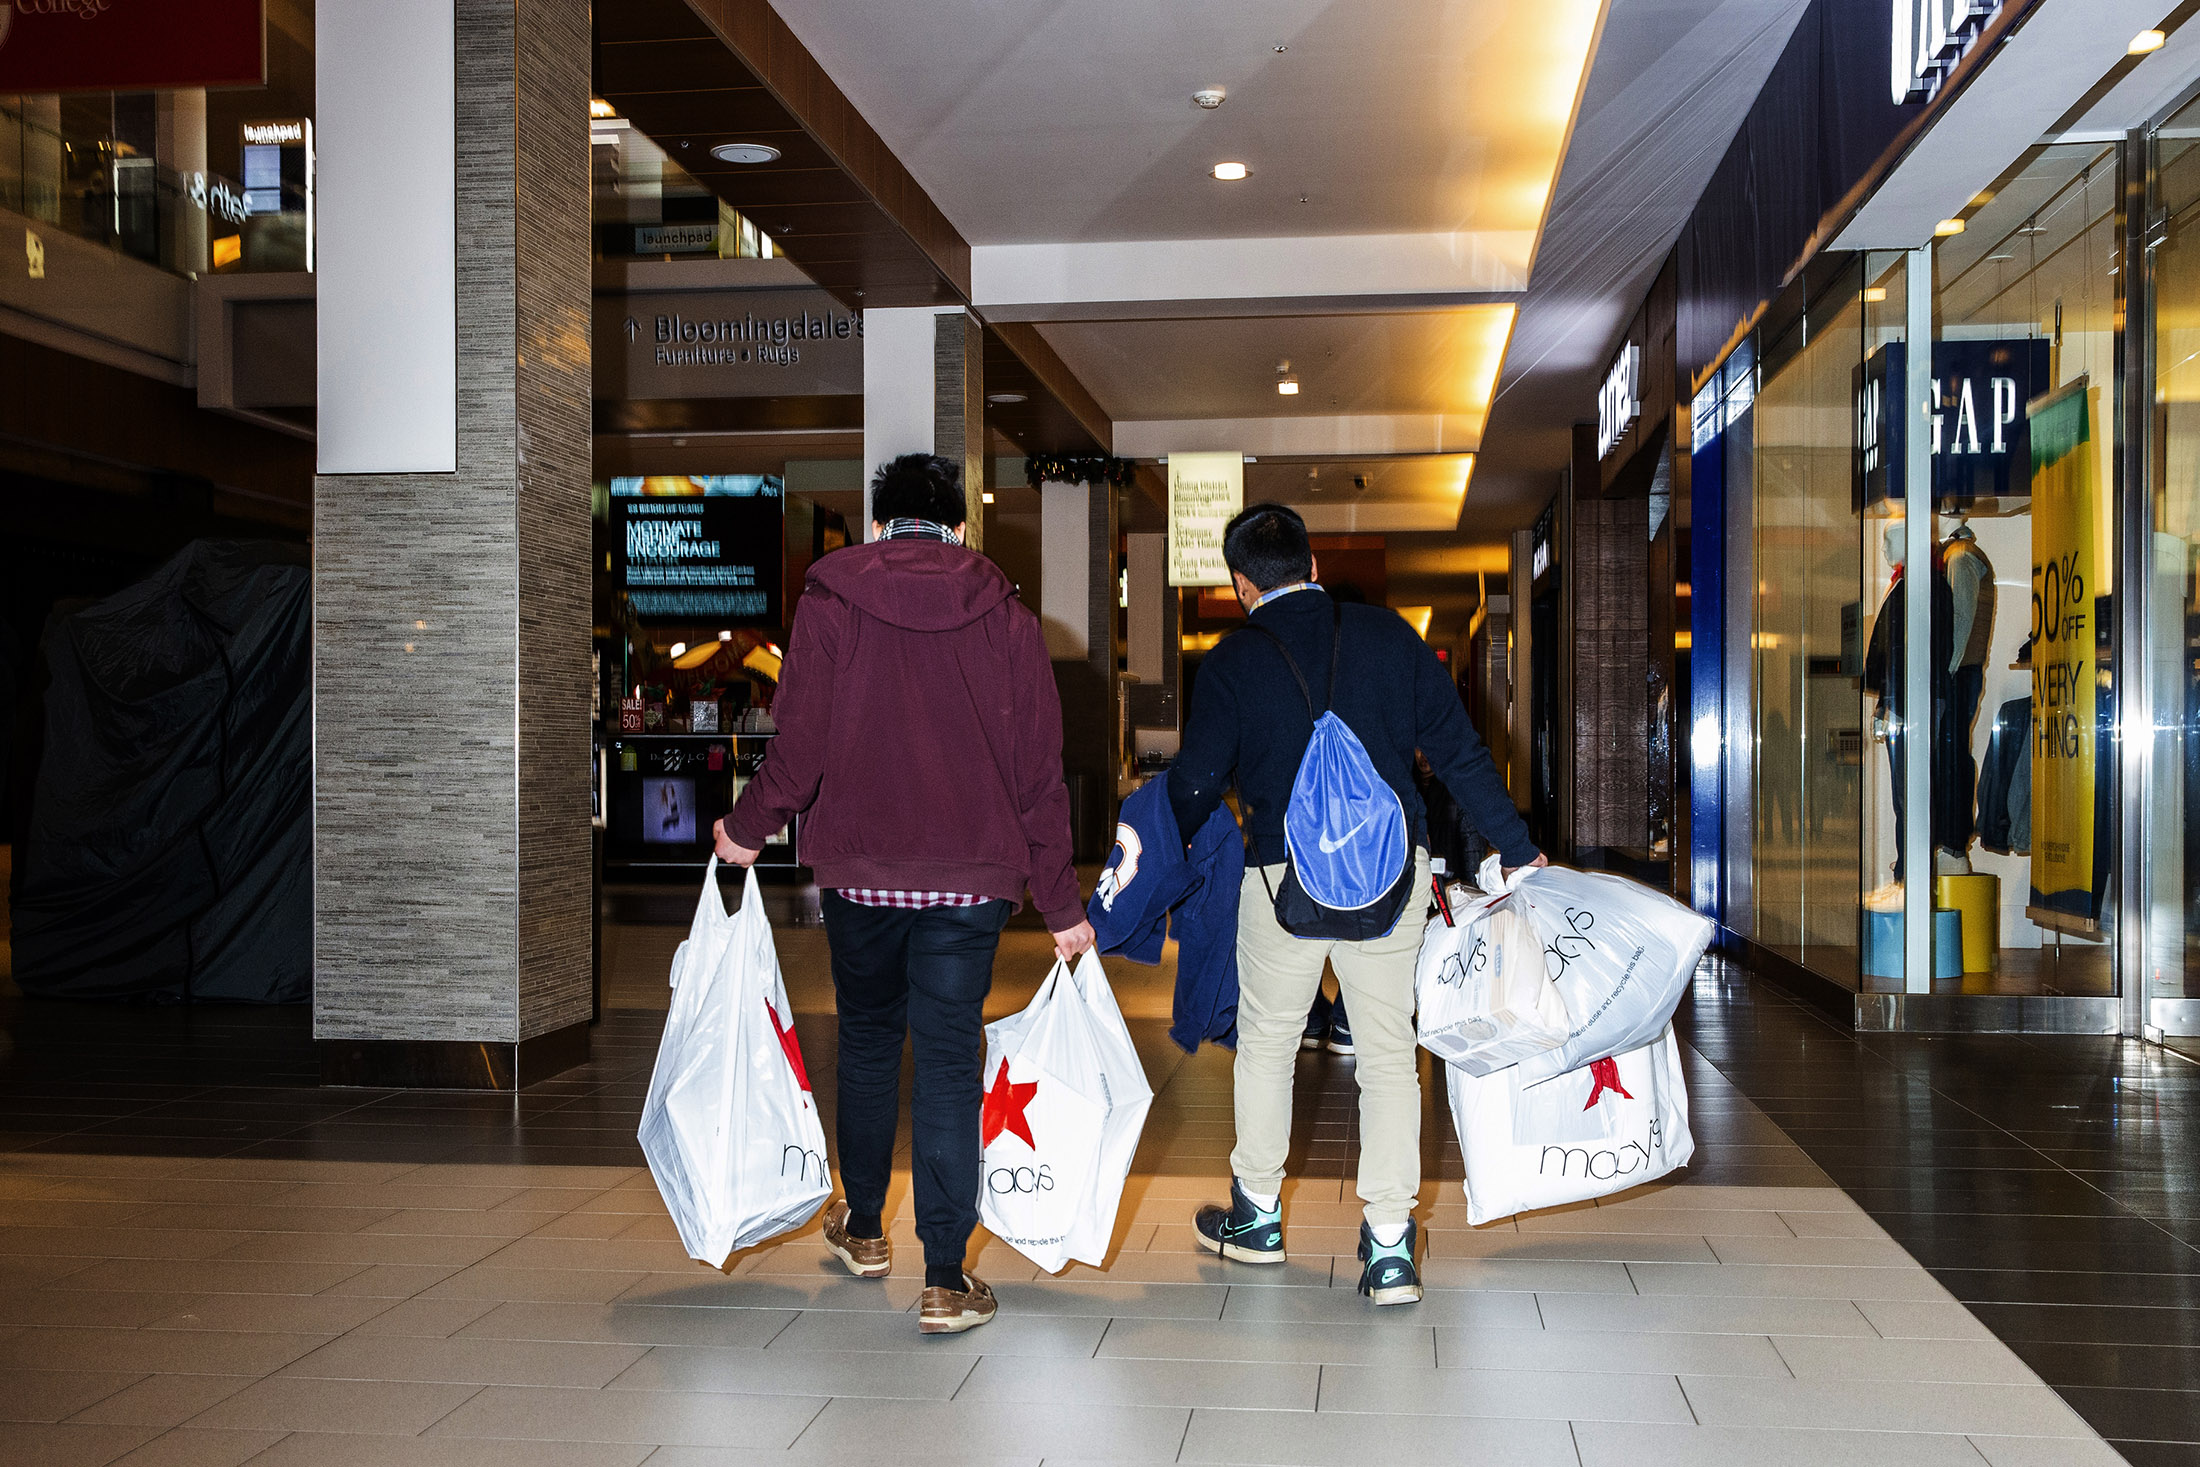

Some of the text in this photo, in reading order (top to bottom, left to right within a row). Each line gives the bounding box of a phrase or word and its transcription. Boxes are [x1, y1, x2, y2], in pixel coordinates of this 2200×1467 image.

[642, 229, 712, 247] launchpad
[656, 309, 864, 347] Bloomingdale's
[656, 344, 800, 367] Furniture Rugs
[2061, 614, 2086, 642] OFF
[621, 698, 642, 710] SALE!
[1601, 998, 1613, 1011] and
[1611, 973, 1631, 1000] recycle
